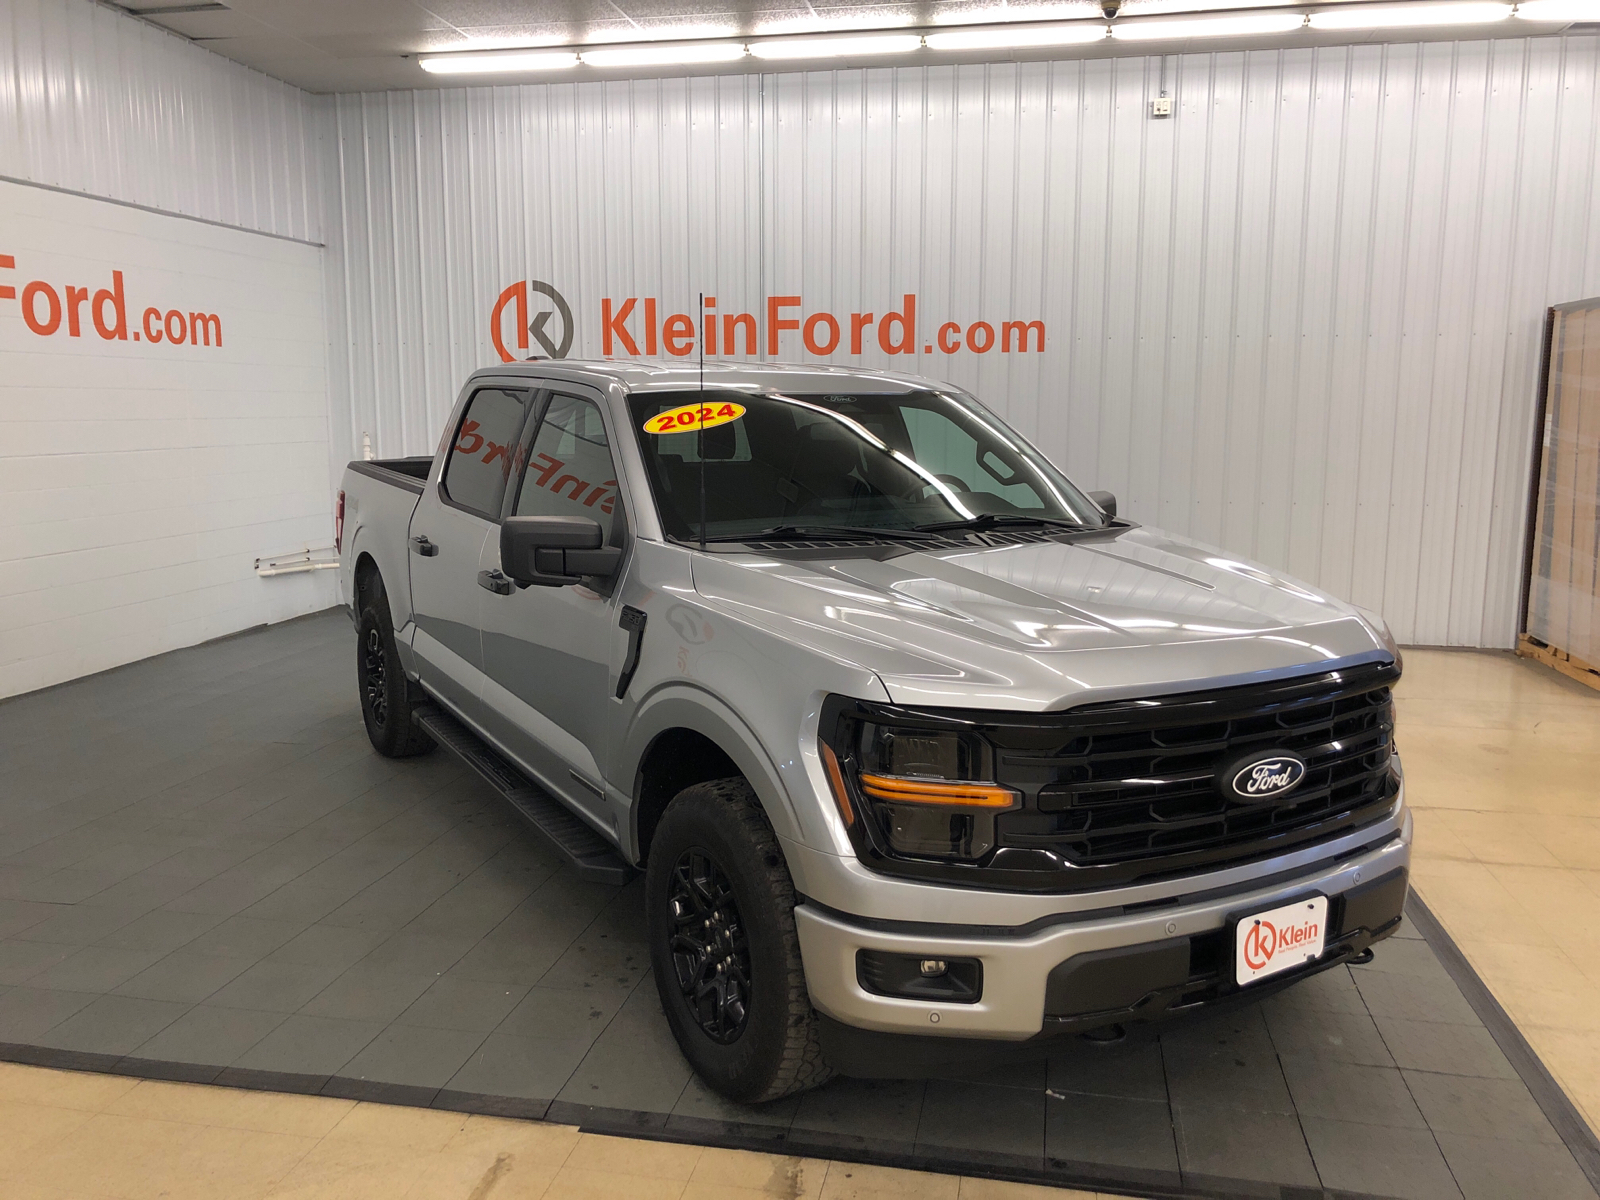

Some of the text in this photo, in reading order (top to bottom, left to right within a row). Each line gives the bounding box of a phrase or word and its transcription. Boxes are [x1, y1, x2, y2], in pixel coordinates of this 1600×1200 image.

[601, 294, 1047, 358] KleinFord.com
[656, 403, 737, 432] 2024
[1247, 763, 1291, 792] Ford
[1278, 921, 1318, 948] Klein
